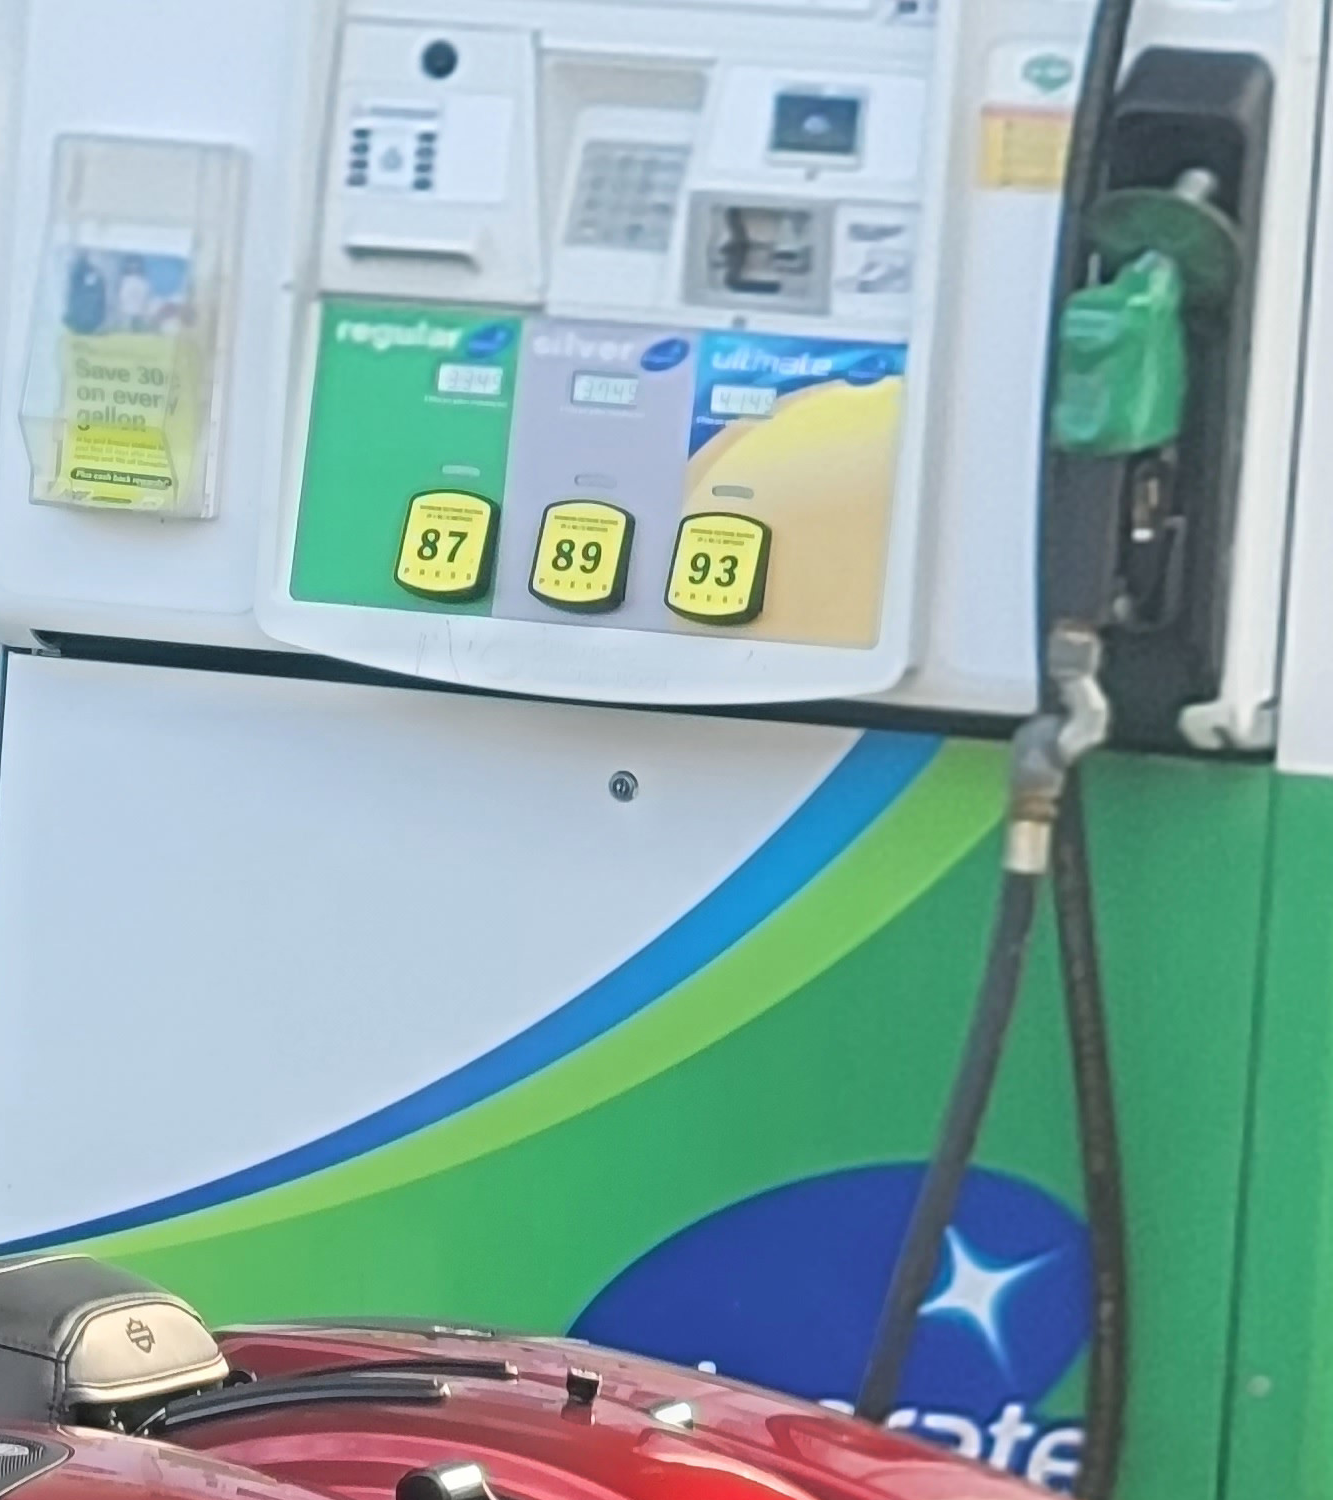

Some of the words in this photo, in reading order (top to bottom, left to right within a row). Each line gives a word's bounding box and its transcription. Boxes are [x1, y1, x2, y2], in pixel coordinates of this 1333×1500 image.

[75, 358, 131, 383] Save
[711, 348, 833, 376] ultimate
[77, 386, 105, 401] on
[77, 406, 146, 432] gallon
[417, 528, 468, 563] 87
[551, 539, 602, 574] 89
[688, 552, 738, 587] 93
